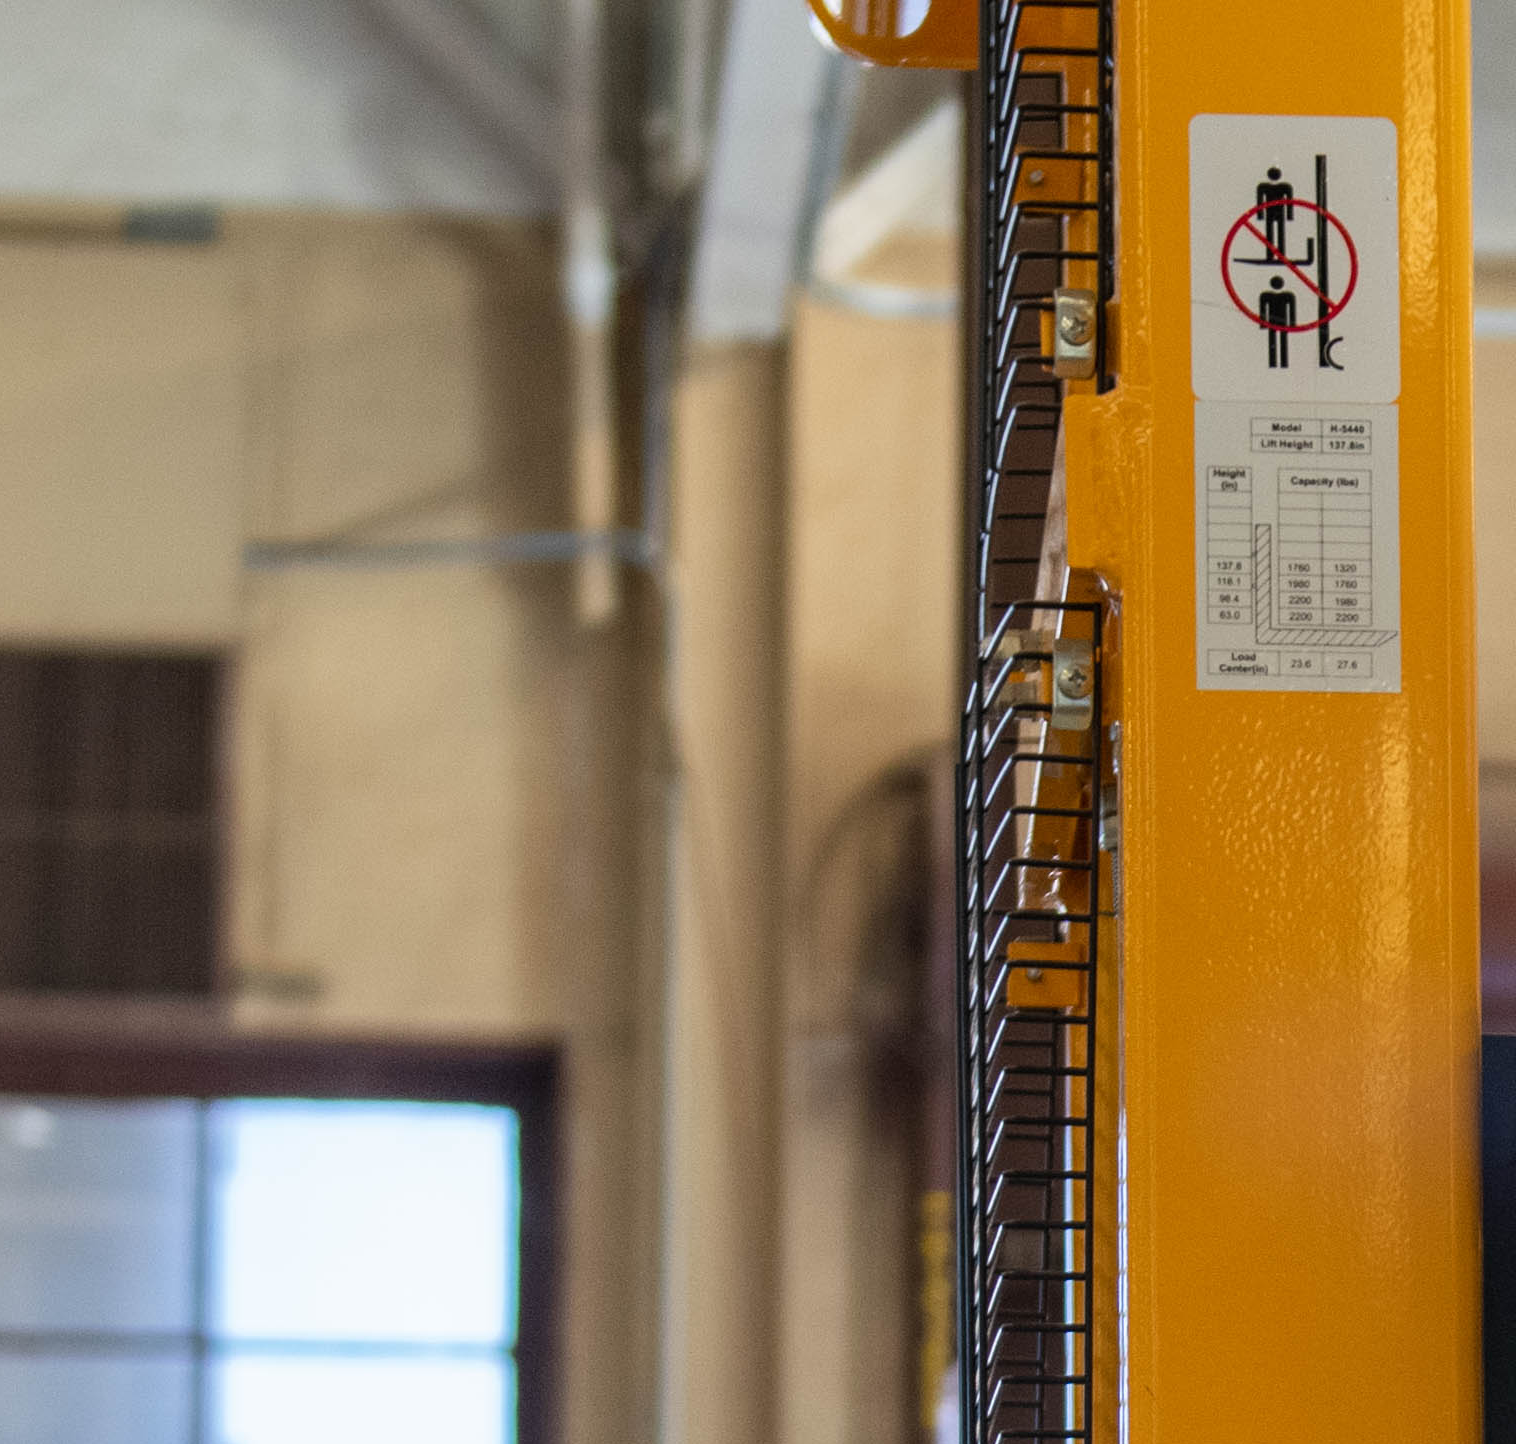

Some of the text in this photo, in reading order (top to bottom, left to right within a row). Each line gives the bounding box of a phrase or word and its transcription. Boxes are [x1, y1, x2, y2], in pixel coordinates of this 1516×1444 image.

[1272, 423, 1365, 434] Model H-5440
[1260, 440, 1277, 449] Lift
[1279, 440, 1313, 450] Height
[1213, 468, 1246, 479] Height
[1221, 480, 1238, 491] (in)
[1290, 476, 1359, 488] Capacity (lbs)
[1288, 596, 1312, 605] 2200
[1289, 612, 1313, 621] 2200
[1335, 613, 1359, 623] 2200
[1231, 653, 1256, 662] Load
[1219, 660, 1358, 675] Center(in) 23.6 27.6
